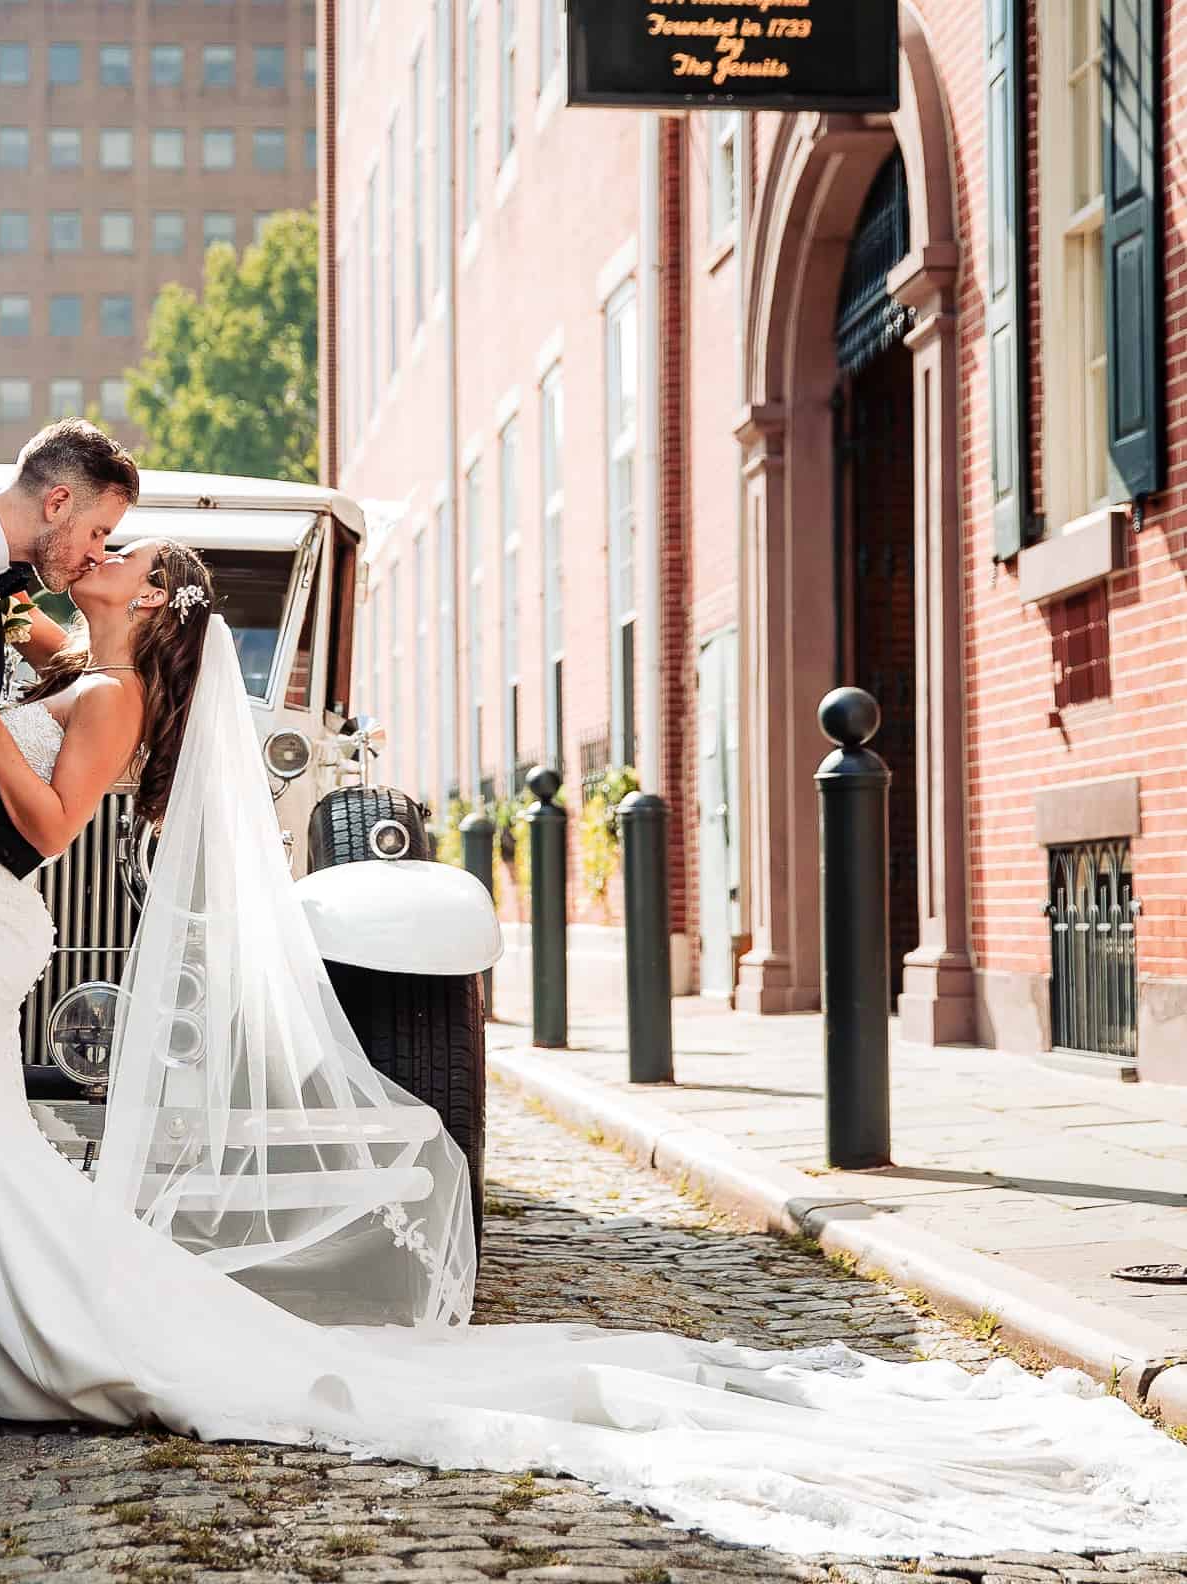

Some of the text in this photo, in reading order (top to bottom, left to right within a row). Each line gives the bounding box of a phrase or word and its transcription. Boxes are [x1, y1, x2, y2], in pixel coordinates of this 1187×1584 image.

[648, 13, 737, 36] Founded
[739, 18, 762, 36] in
[715, 37, 744, 60] by
[672, 53, 789, 84] The Jesuits
